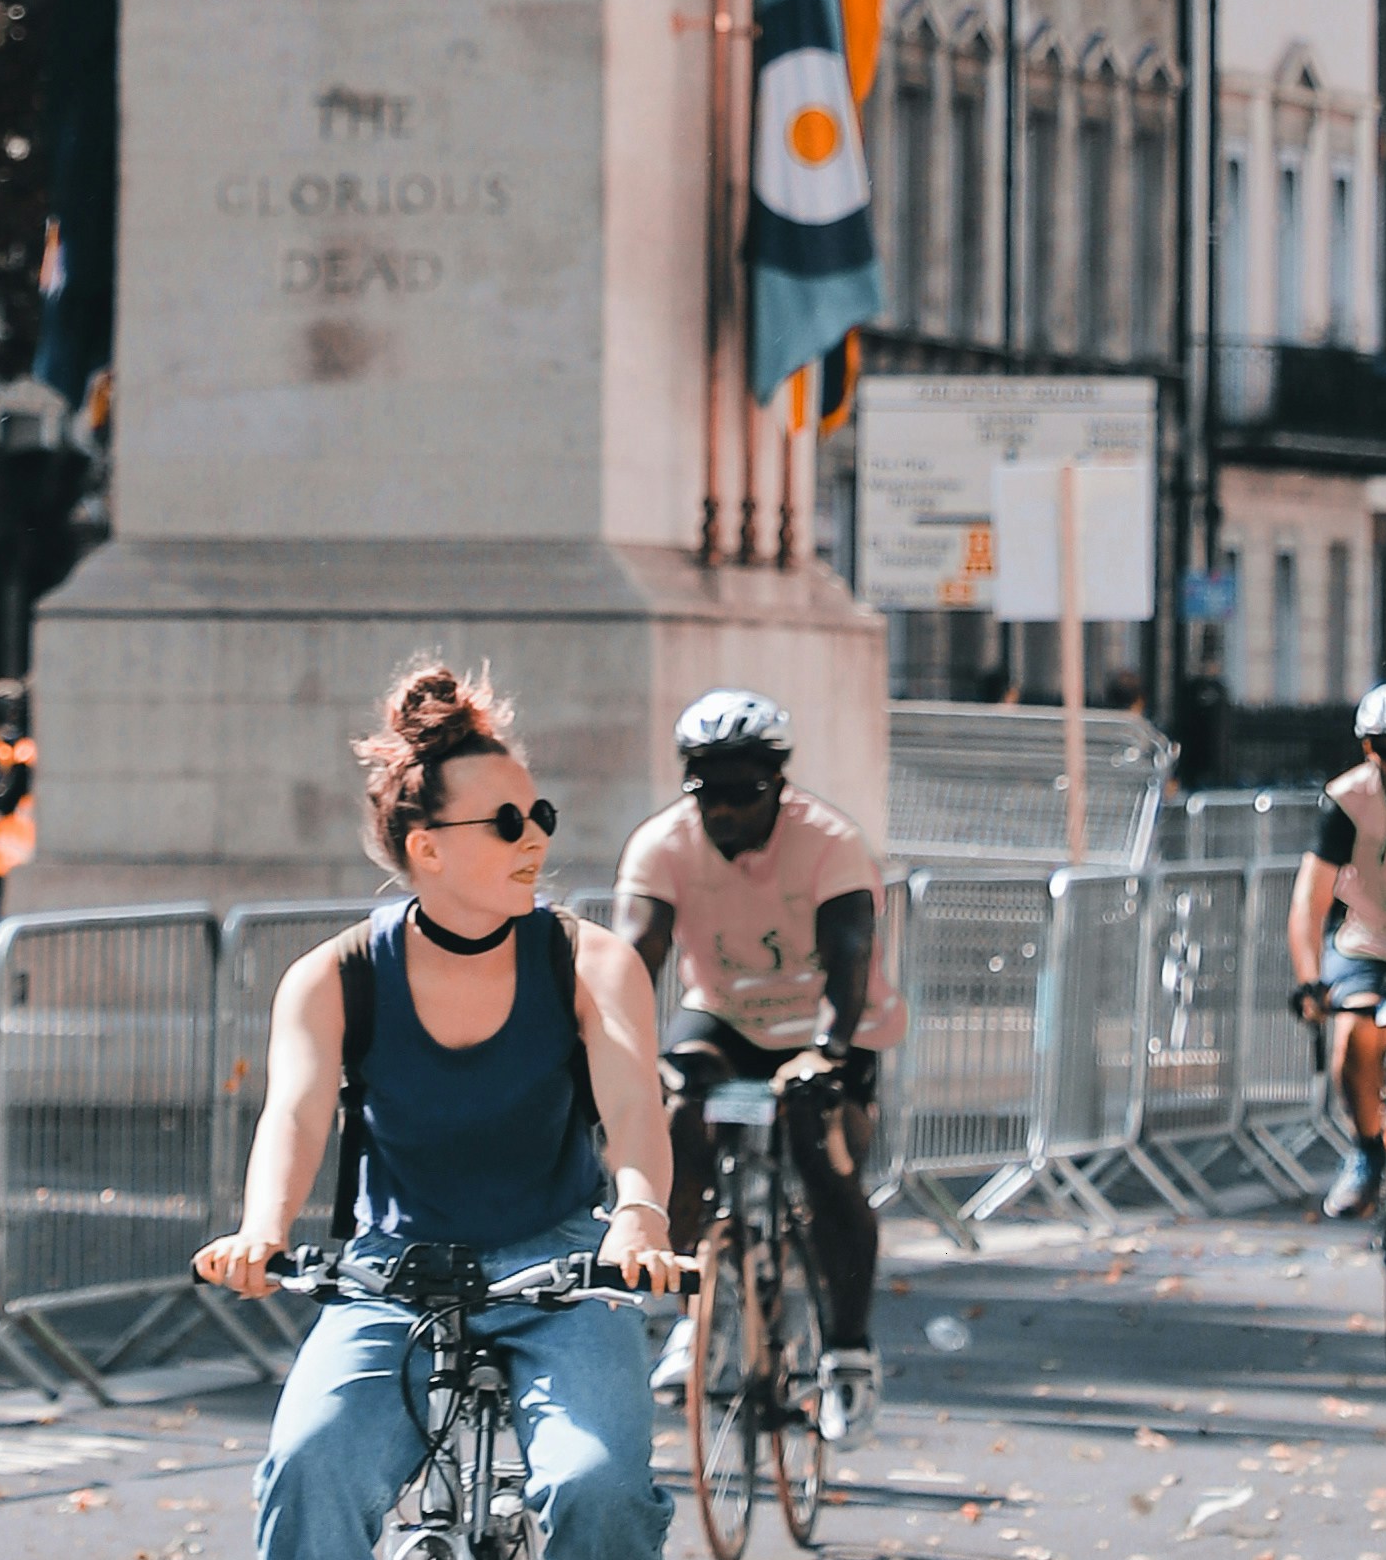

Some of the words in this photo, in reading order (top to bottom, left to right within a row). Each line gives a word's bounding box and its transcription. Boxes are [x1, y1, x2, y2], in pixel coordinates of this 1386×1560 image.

[311, 91, 417, 142] THE
[213, 171, 512, 218] GLORIOUS
[281, 247, 446, 294] DEAD
